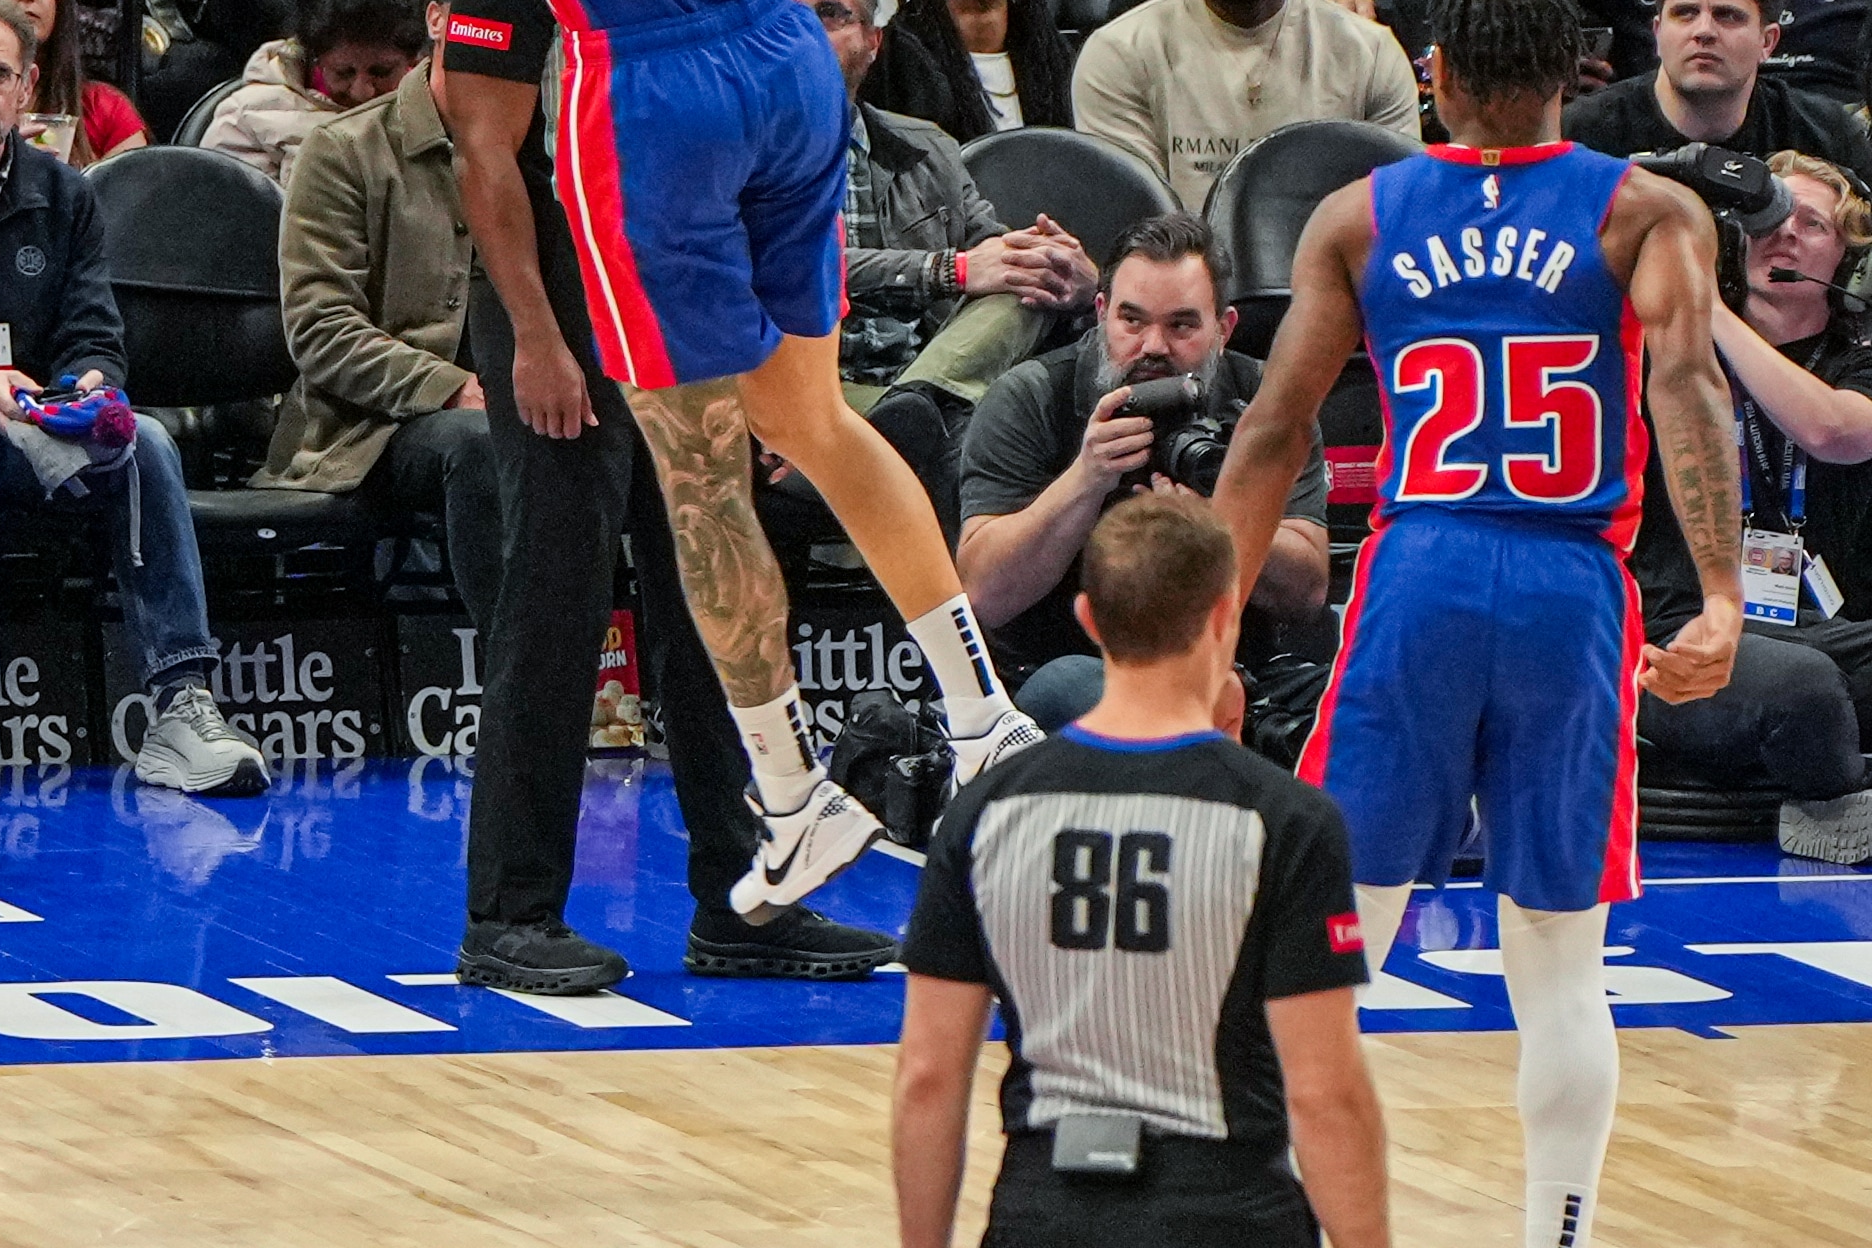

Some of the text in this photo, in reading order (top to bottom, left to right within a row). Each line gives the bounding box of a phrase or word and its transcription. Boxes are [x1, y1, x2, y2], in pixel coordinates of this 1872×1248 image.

[450, 20, 505, 43] Emirates
[1172, 136, 1240, 154] RMANI
[1392, 226, 1576, 299] SASSER
[1393, 334, 1603, 503] 25
[210, 633, 334, 703] ittle
[792, 621, 924, 692] ittle
[1051, 828, 1173, 953] 86
